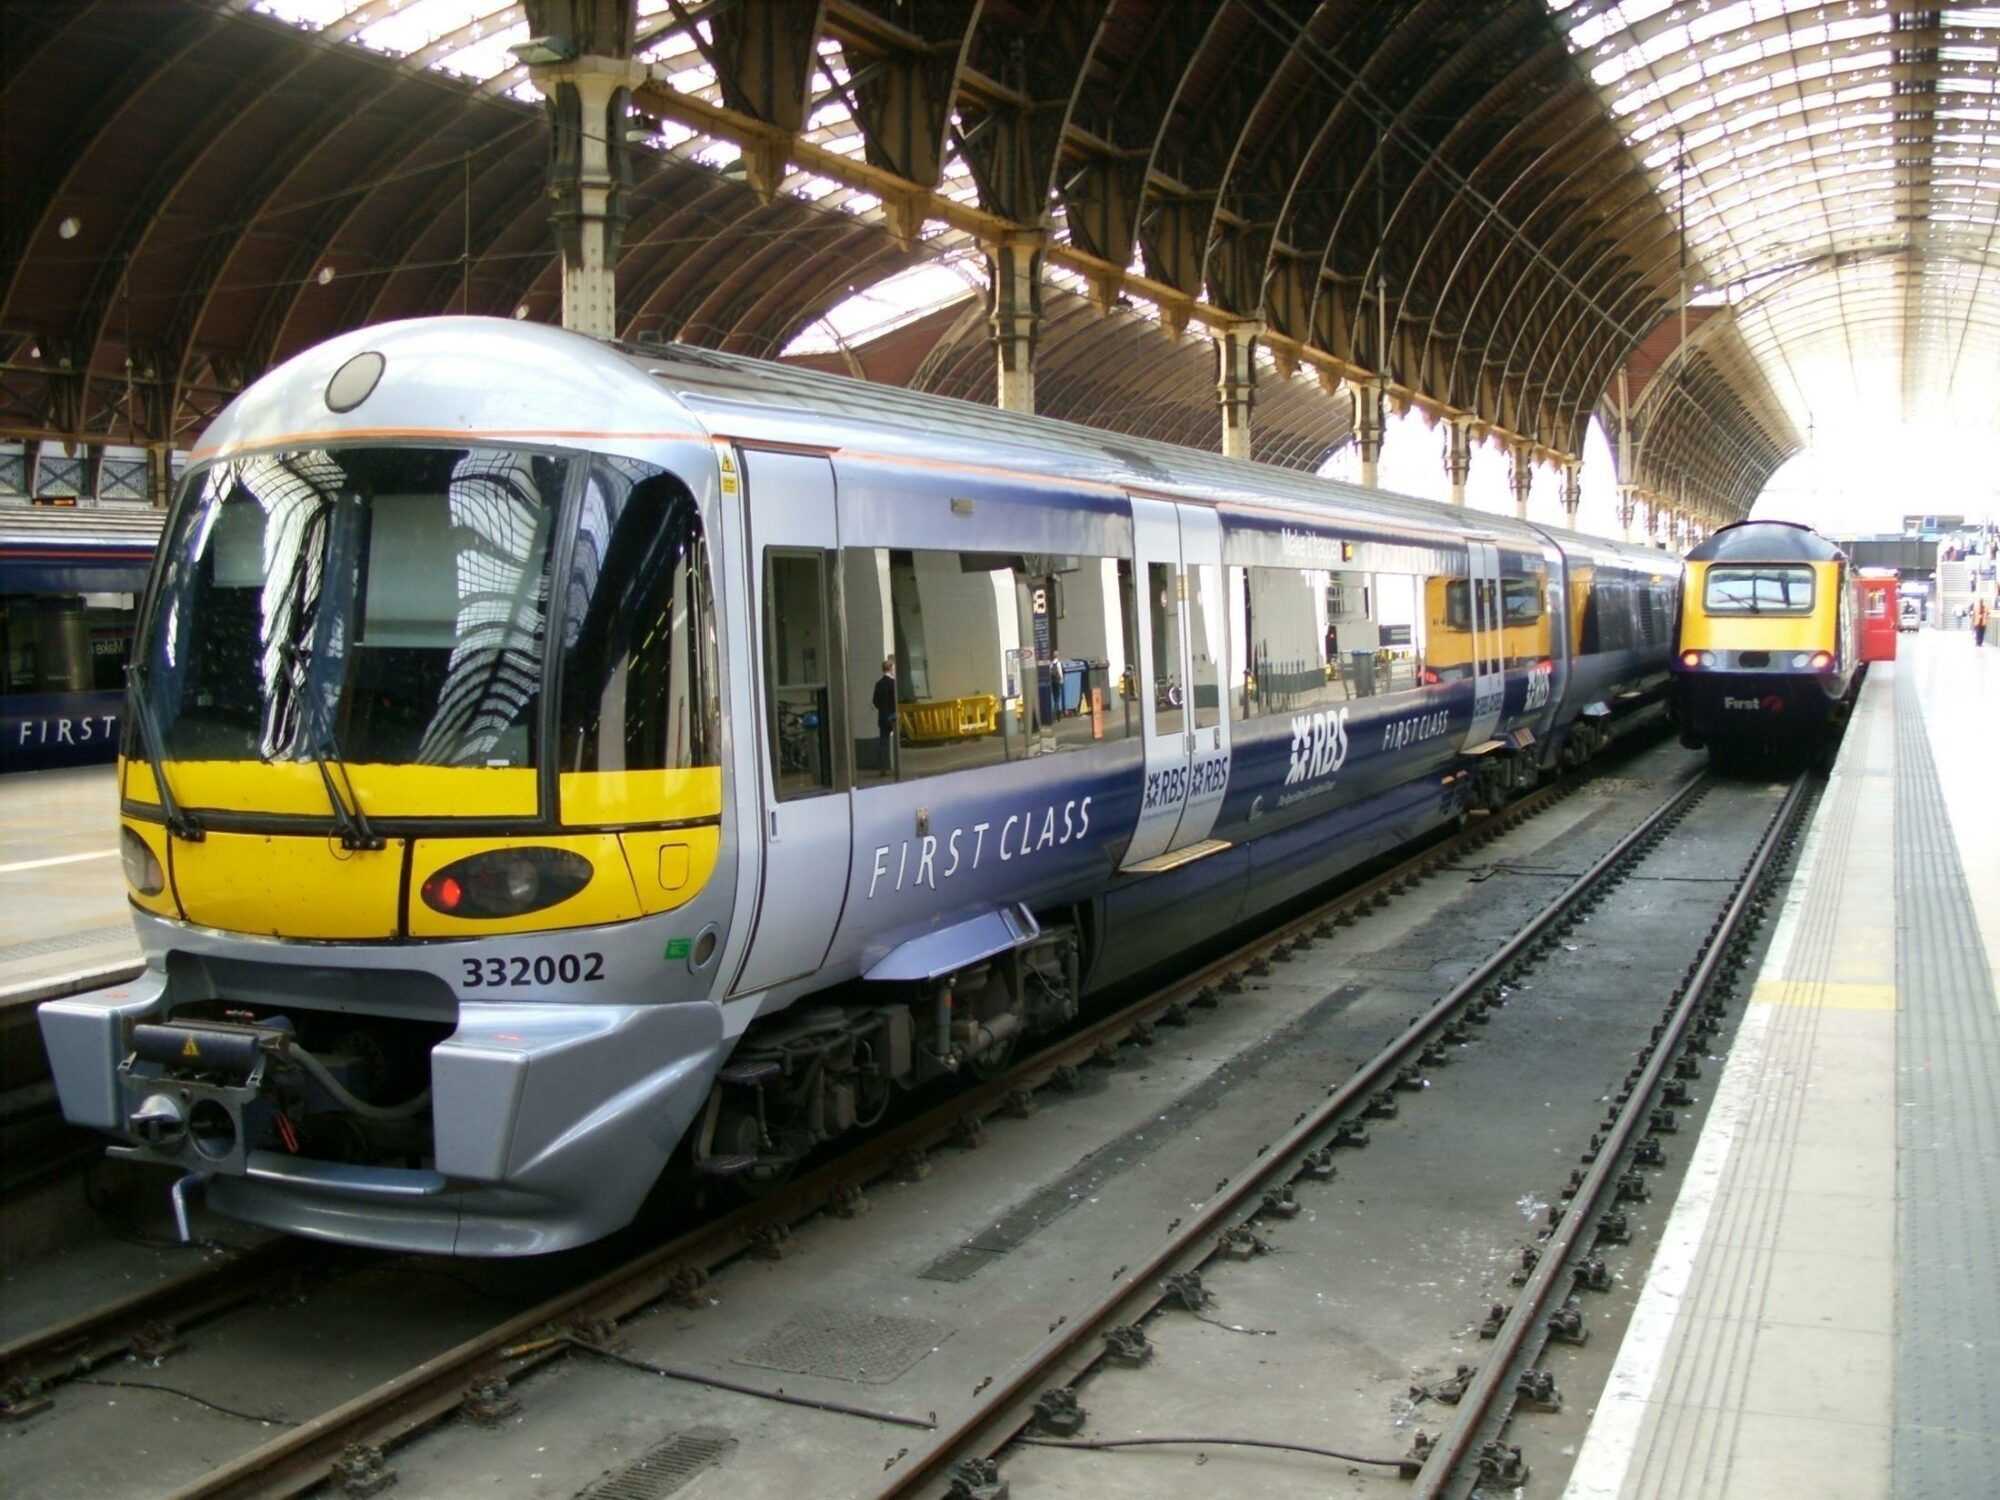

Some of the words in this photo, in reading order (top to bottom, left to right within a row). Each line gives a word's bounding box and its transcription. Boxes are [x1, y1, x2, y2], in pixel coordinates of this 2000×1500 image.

[1724, 696, 1760, 710] First
[20, 716, 116, 746] FIRST
[1307, 706, 1349, 780] RBS
[1382, 716, 1419, 752] FIRST
[1418, 709, 1449, 741] CLASS
[1159, 766, 1187, 807] RBS
[1202, 756, 1229, 795] RBS
[868, 822, 990, 899] FIRST
[999, 796, 1092, 861] CLASS
[462, 951, 605, 988] 332002
